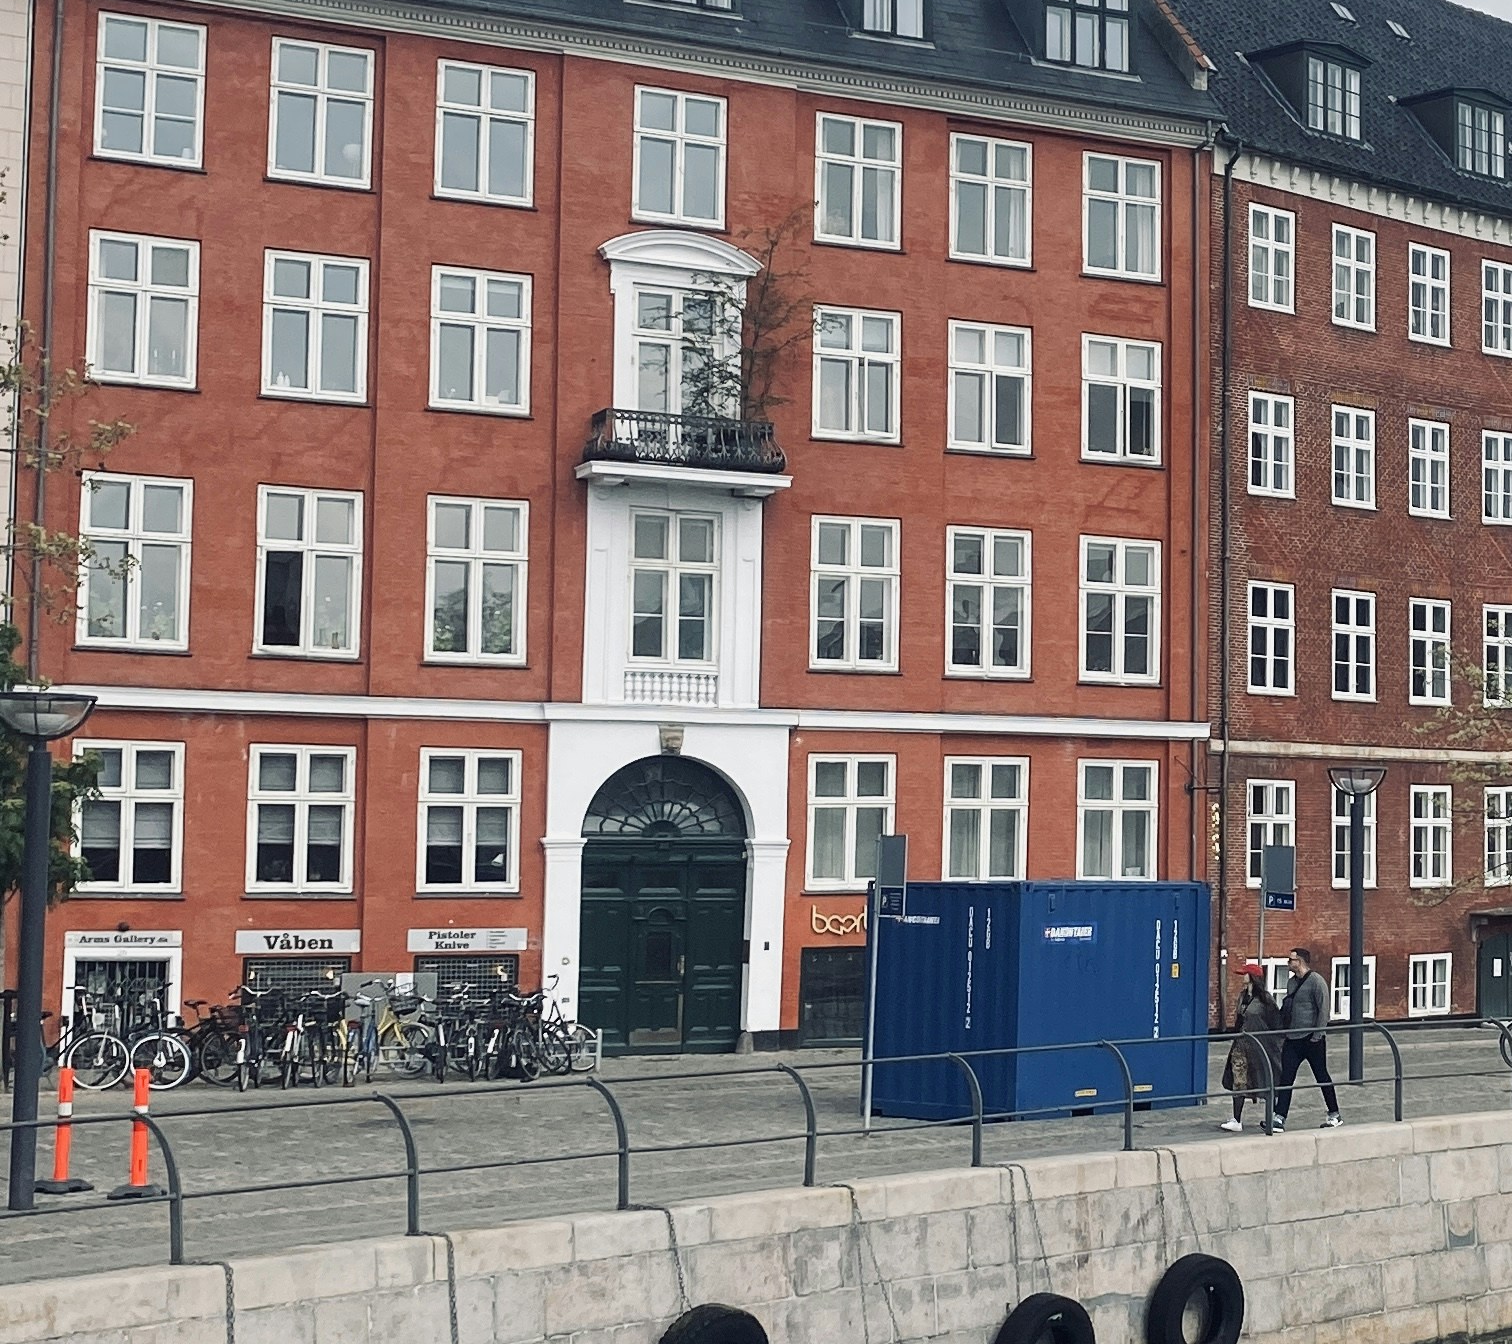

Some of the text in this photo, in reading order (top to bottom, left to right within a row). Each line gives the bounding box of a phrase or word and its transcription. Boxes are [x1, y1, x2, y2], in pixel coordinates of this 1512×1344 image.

[79, 935, 110, 944] Arms
[428, 930, 476, 940] Pistoler
[263, 933, 334, 950] Våben
[434, 941, 470, 950] Knive
